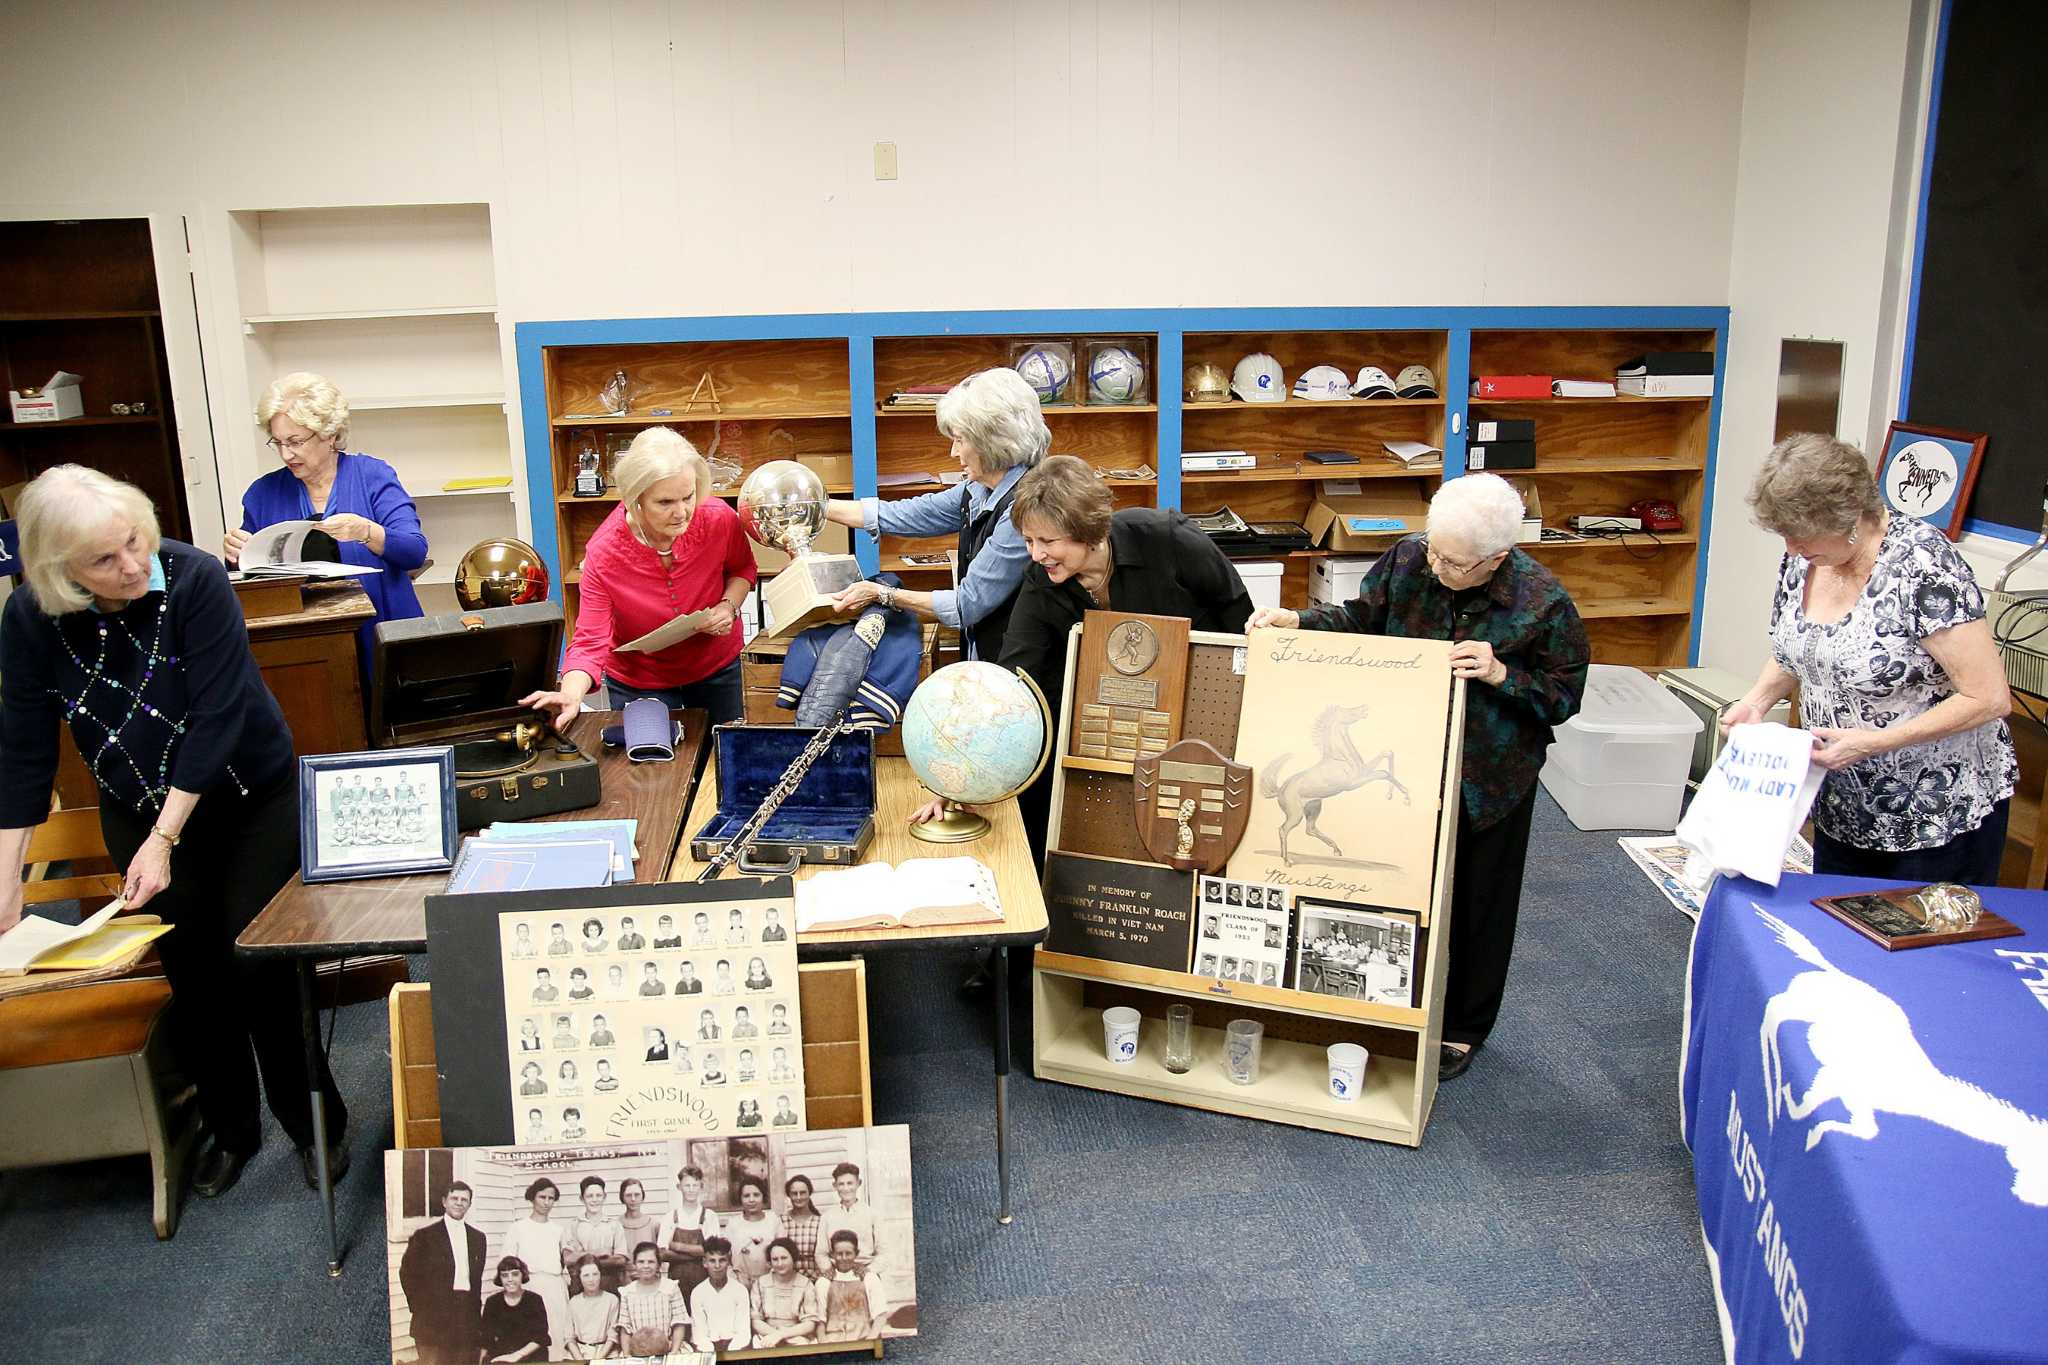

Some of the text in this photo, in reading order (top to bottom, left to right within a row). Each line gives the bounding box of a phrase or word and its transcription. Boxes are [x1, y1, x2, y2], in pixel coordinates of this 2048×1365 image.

[1270, 636, 1423, 670] Friendswood
[1755, 778, 1797, 799] LADY
[1087, 884, 1152, 900] IN MEMORY OF
[1265, 867, 1373, 900] Mustangs
[1099, 900, 1151, 916] FRANKLIN
[1154, 908, 1187, 921] ROACH
[1087, 926, 1115, 938] MARCH
[1130, 934, 1149, 943] 1970
[1108, 916, 1117, 925] IN
[1121, 919, 1141, 929] VIET
[1145, 922, 1165, 932] NAM
[605, 1086, 720, 1138] FRIENDSWOOD
